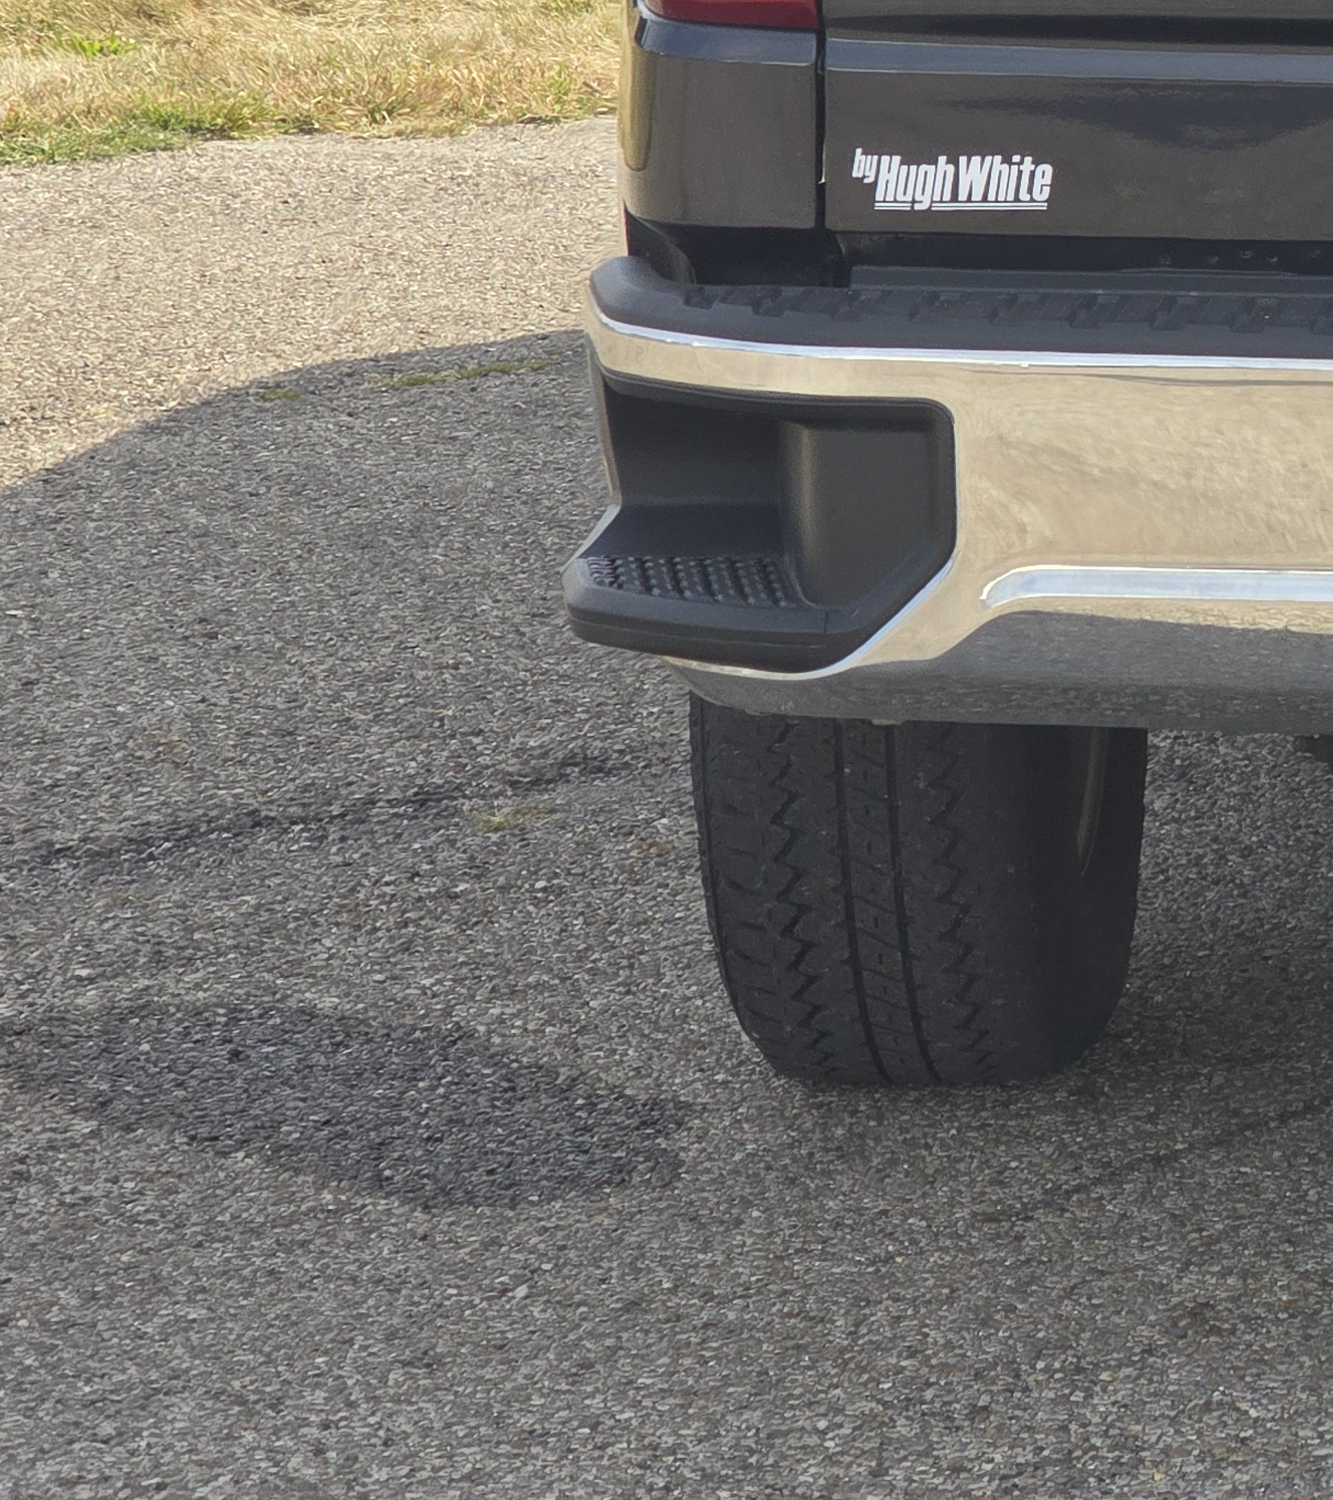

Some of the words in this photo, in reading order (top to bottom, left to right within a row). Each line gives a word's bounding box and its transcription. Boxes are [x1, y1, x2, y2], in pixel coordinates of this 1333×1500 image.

[852, 148, 879, 184] by
[874, 155, 956, 211] Hugh
[957, 155, 1054, 202] White
